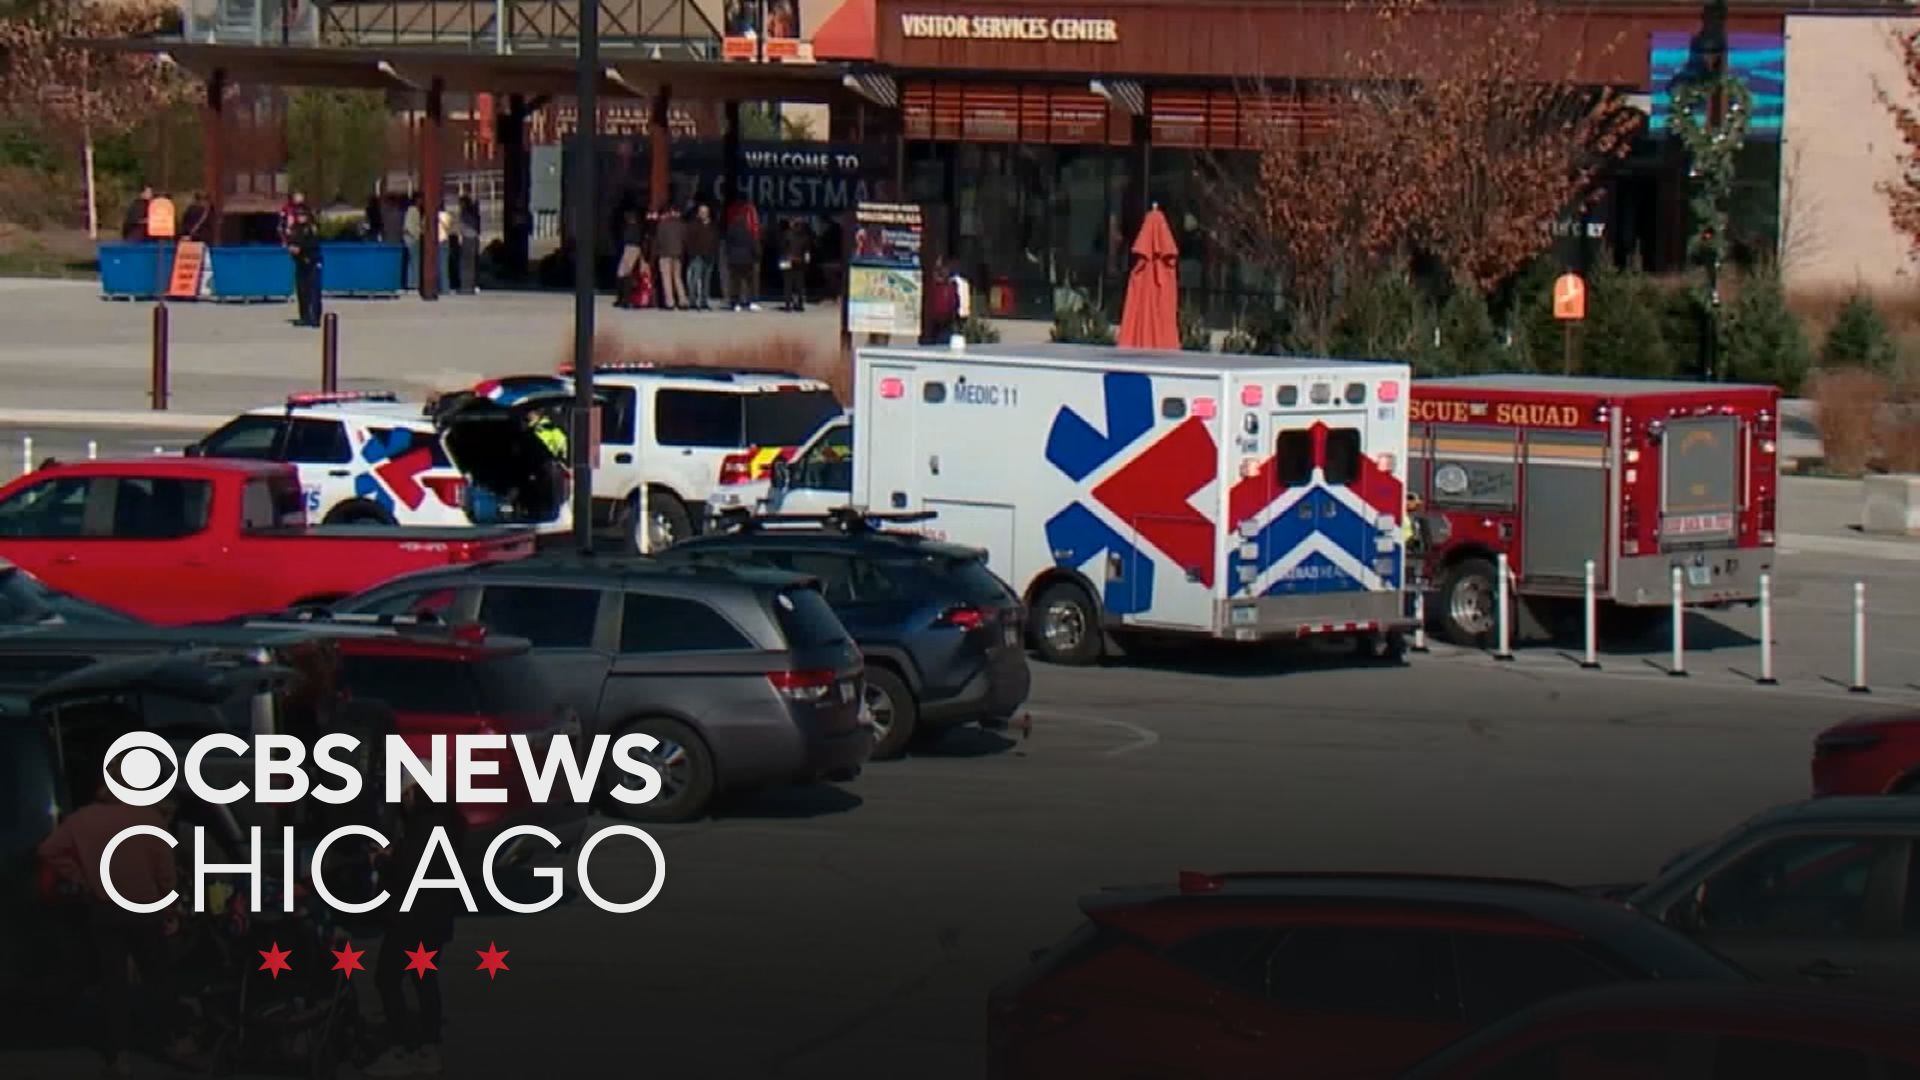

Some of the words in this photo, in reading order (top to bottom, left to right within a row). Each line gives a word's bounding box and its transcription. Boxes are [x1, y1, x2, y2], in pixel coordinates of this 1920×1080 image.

[902, 14, 969, 38] VISITOR
[972, 16, 1048, 39] SERVICES
[1051, 18, 1117, 41] CENTER
[745, 151, 829, 168] WELCOME
[836, 154, 859, 168] TO
[954, 383, 999, 404] MEDIC
[1004, 386, 1017, 407] 11
[1410, 400, 1468, 422] SCUE
[1496, 402, 1579, 427] SQUAD
